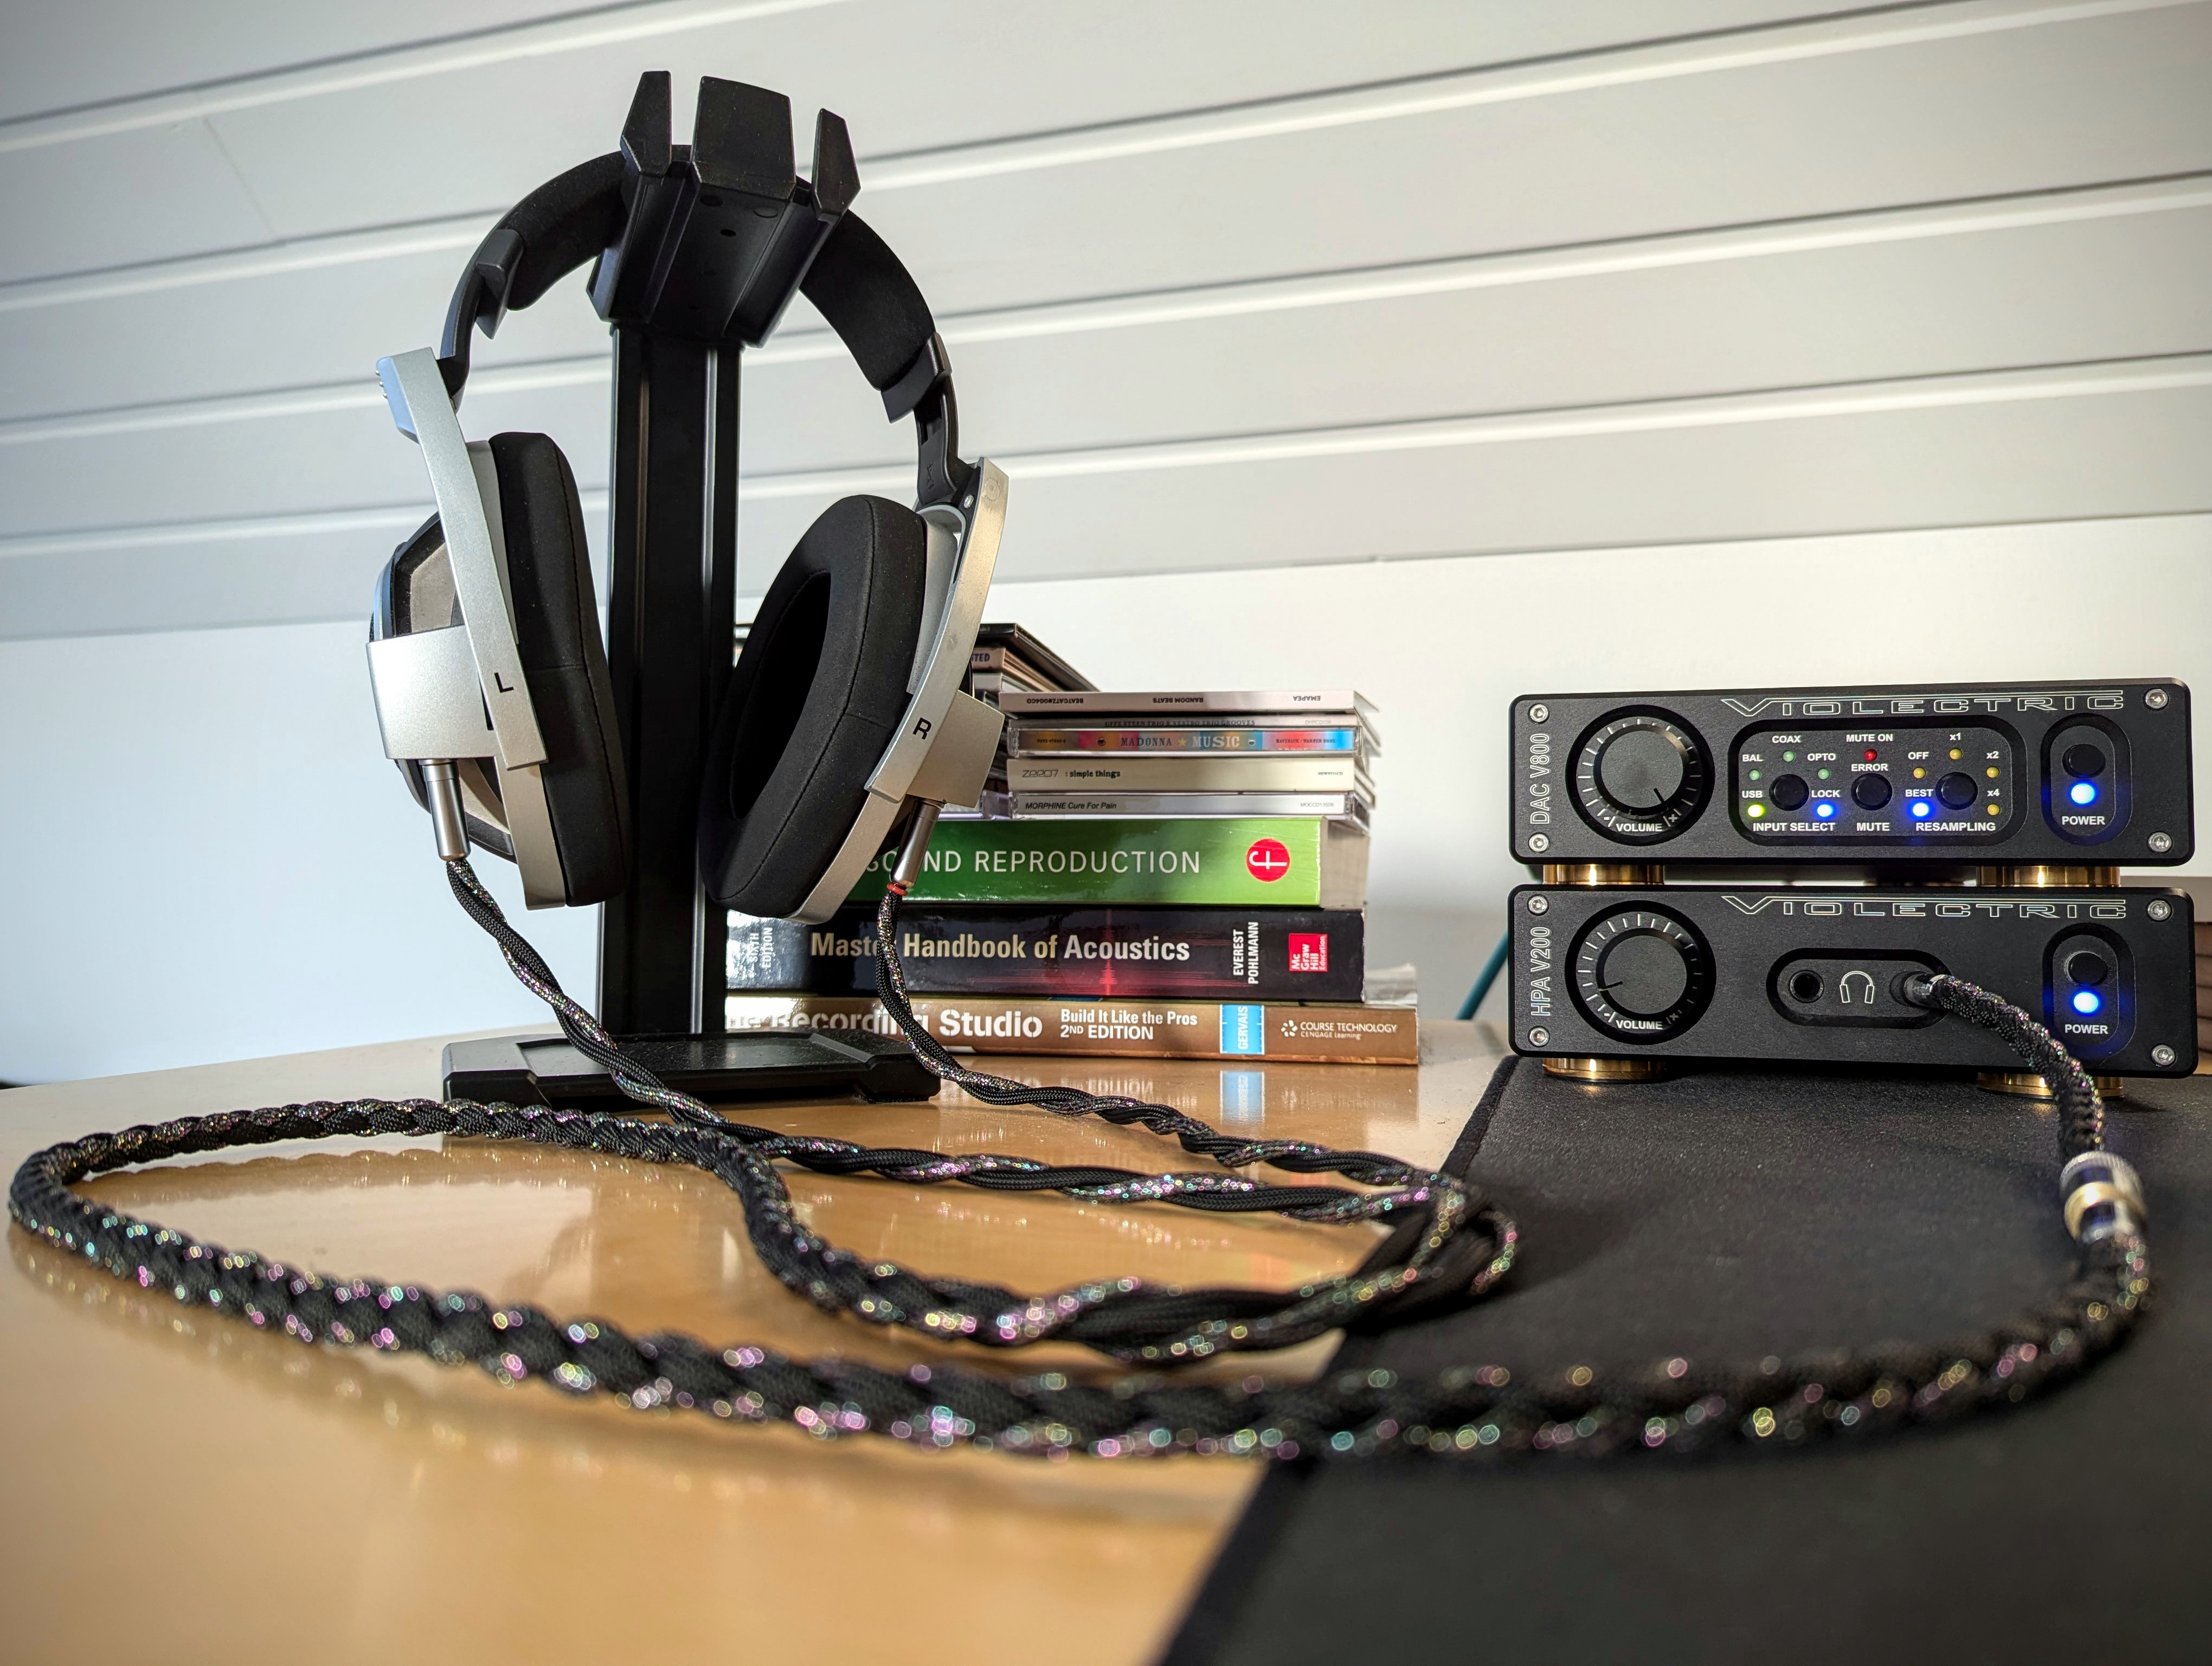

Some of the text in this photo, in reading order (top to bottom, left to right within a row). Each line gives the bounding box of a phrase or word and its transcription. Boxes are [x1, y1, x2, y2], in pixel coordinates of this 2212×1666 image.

[494, 672, 514, 693] L
[1721, 690, 2124, 716] VIOLECTRIC
[912, 717, 931, 740] R
[1121, 736, 1240, 747] MADONNA MUSIC
[1772, 735, 1801, 744] COAX
[1846, 733, 1893, 742] MUTE ON
[1742, 754, 1762, 762] BAL
[1808, 753, 1836, 761] OPTO
[1908, 752, 1929, 760] OFF
[1986, 751, 1998, 759] x2
[1851, 764, 1888, 772] ERROR
[1070, 770, 1094, 779] simple
[1095, 770, 1121, 779] things
[1531, 733, 1549, 824] DAC V800
[1742, 790, 1763, 798] USB
[1811, 790, 1840, 798] LOCK
[1905, 789, 1933, 798] BEST
[1987, 789, 1999, 797] x4
[2062, 816, 2105, 825] POWER
[1616, 823, 1662, 832] VOLUME
[1753, 823, 1835, 831] INPUT SELECT
[1856, 823, 1889, 831] MUTE
[1916, 823, 1996, 831] RESAMPLING
[975, 850, 1200, 873] REPRODUCTION
[1721, 895, 2126, 919] VIOLECTRIC
[811, 932, 1190, 960] Mast Handbook of Acoustics
[1233, 930, 1244, 976] EVEREST
[1248, 922, 1259, 984] POHLMANN
[1301, 944, 1310, 970] Graw
[1291, 953, 1300, 970] Mc
[1310, 953, 1319, 970] Hill
[1531, 925, 1552, 1017] HPA V200
[1061, 1009, 1197, 1025] Build It Like the Pros
[939, 1009, 1043, 1038] Studio
[1238, 1006, 1248, 1050] GERVAIS
[1300, 1022, 1397, 1033] COURSE TECHNOLOGY
[1616, 1020, 1663, 1030] VOLUME
[1060, 1024, 1153, 1039] 2ND EDITION
[2065, 1024, 2108, 1035] POWER
